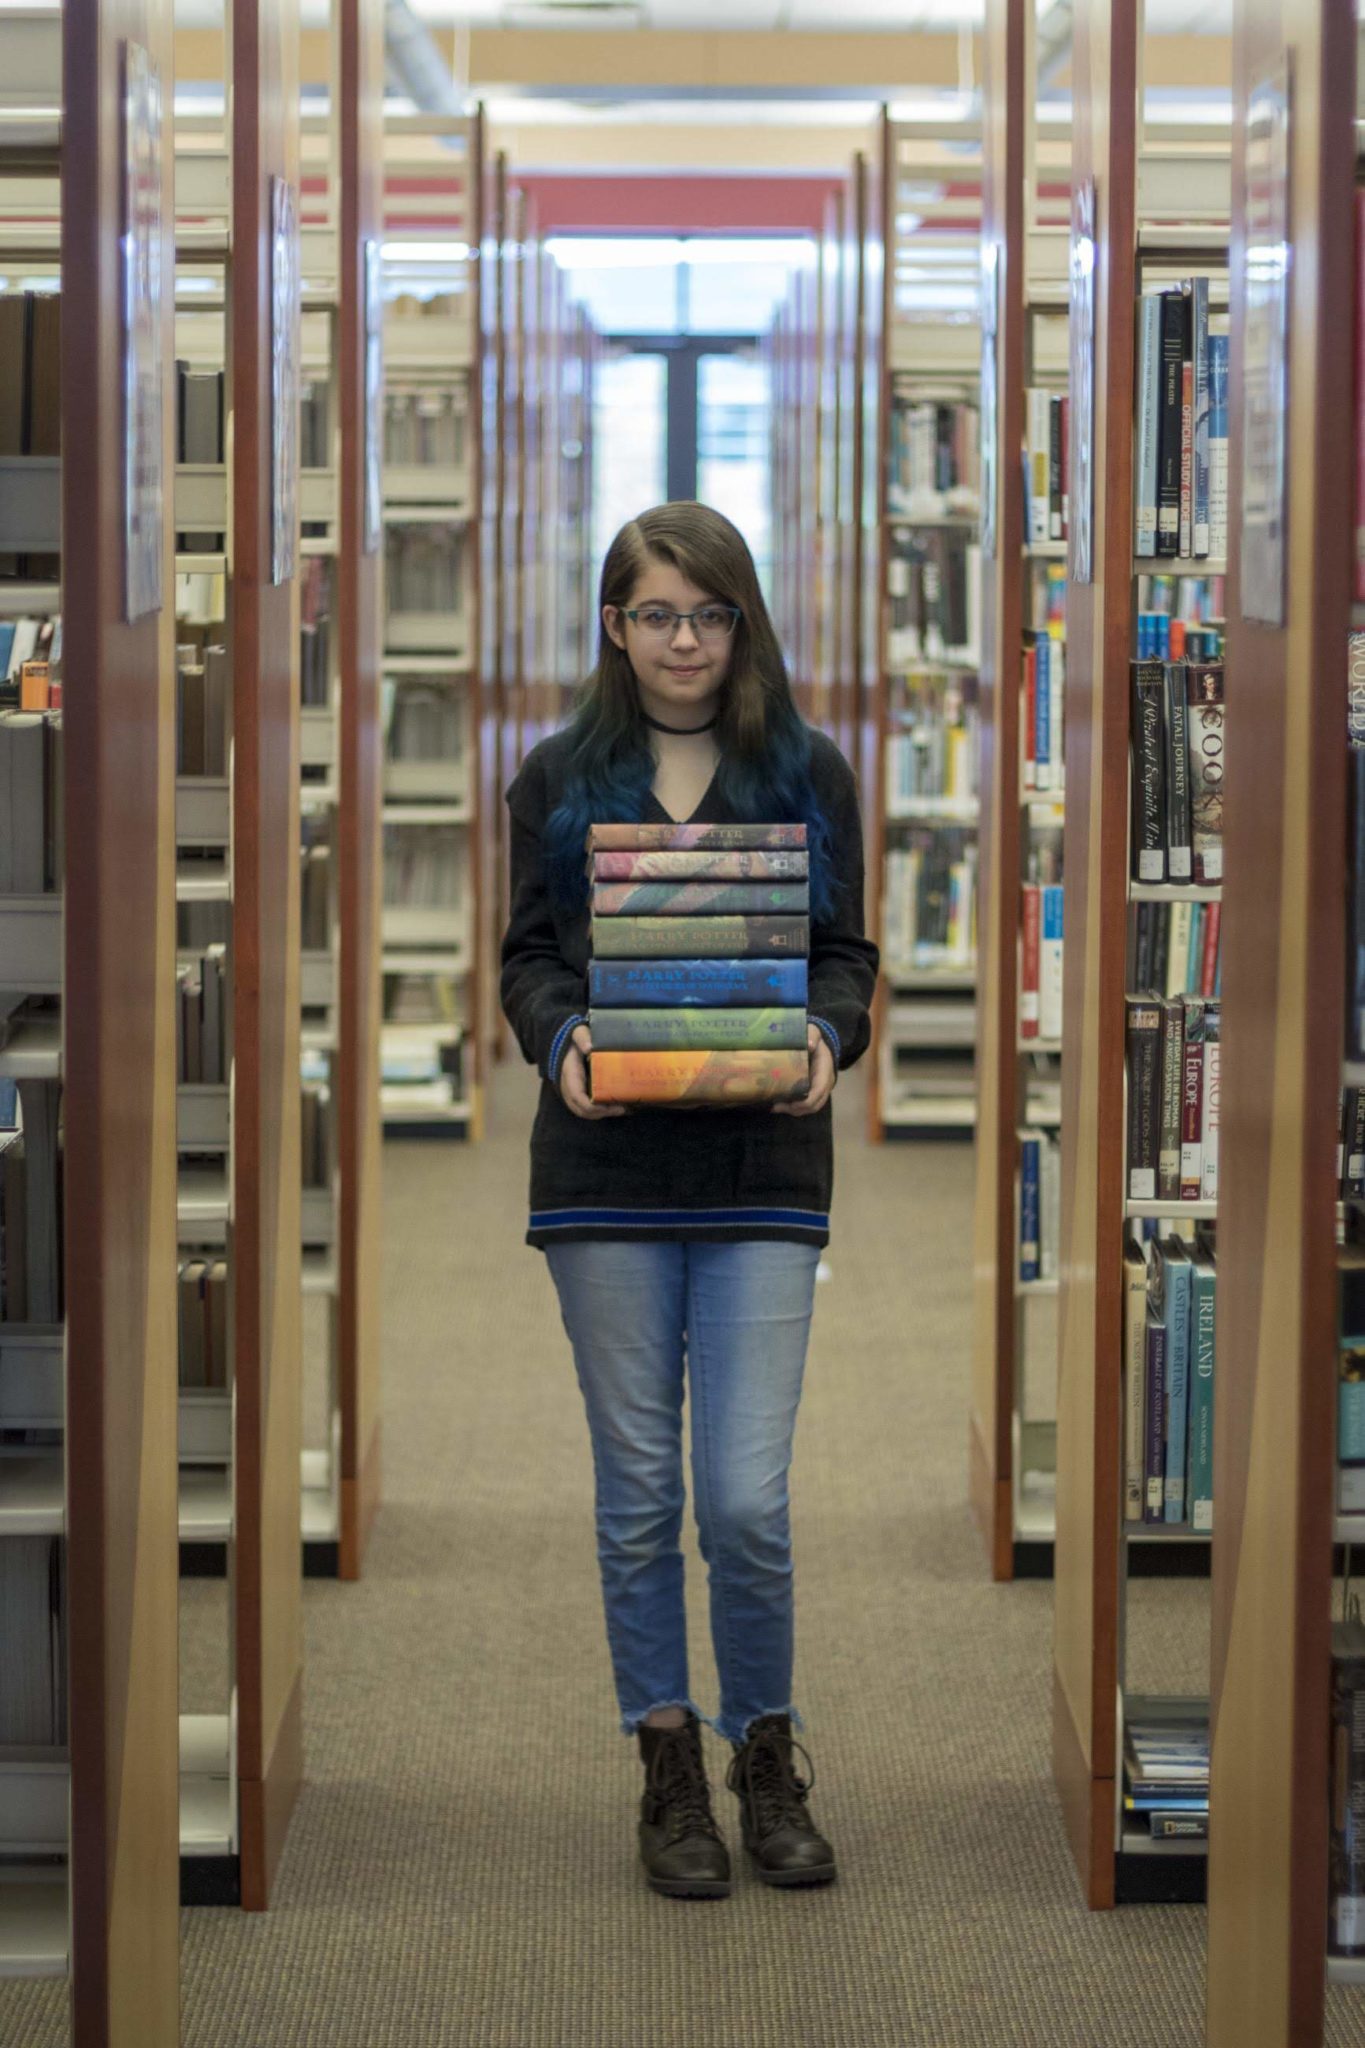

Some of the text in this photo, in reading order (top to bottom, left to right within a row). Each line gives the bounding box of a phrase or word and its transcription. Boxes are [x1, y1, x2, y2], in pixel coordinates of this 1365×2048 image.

[1167, 364, 1176, 406] THE PIRATES
[1180, 404, 1192, 522] OFFICIAL STUDY GUIDE
[1143, 709, 1159, 747] Pirate
[1144, 749, 1157, 763] of
[1173, 706, 1184, 796] FATAL JOURNEY
[1201, 709, 1223, 809] COOK
[1140, 764, 1160, 817] Exquisite
[1144, 821, 1160, 849] Min
[627, 970, 685, 982] HARRY
[689, 1019, 749, 1029] POTTER
[1166, 1020, 1174, 1039] AND
[1143, 1044, 1153, 1062] THE
[1165, 1041, 1174, 1102] ANGLO-SAXON
[1172, 1020, 1182, 1128] EVERYDAY LIFE IN ROMAN
[1142, 1064, 1153, 1106] ANCIENT
[1185, 1058, 1202, 1106] EUROPE
[1142, 1108, 1151, 1138] GODS
[1163, 1104, 1172, 1128] TIMES
[1174, 1276, 1187, 1332] CASTLES
[1154, 1335, 1164, 1377] PORTRAIT
[1198, 1296, 1214, 1378] IRELAND
[1133, 1374, 1142, 1408] BRITAIN
[1154, 1379, 1163, 1390] OF
[1172, 1345, 1185, 1398] BRITAIN
[1153, 1391, 1163, 1434] SCOTLAND
